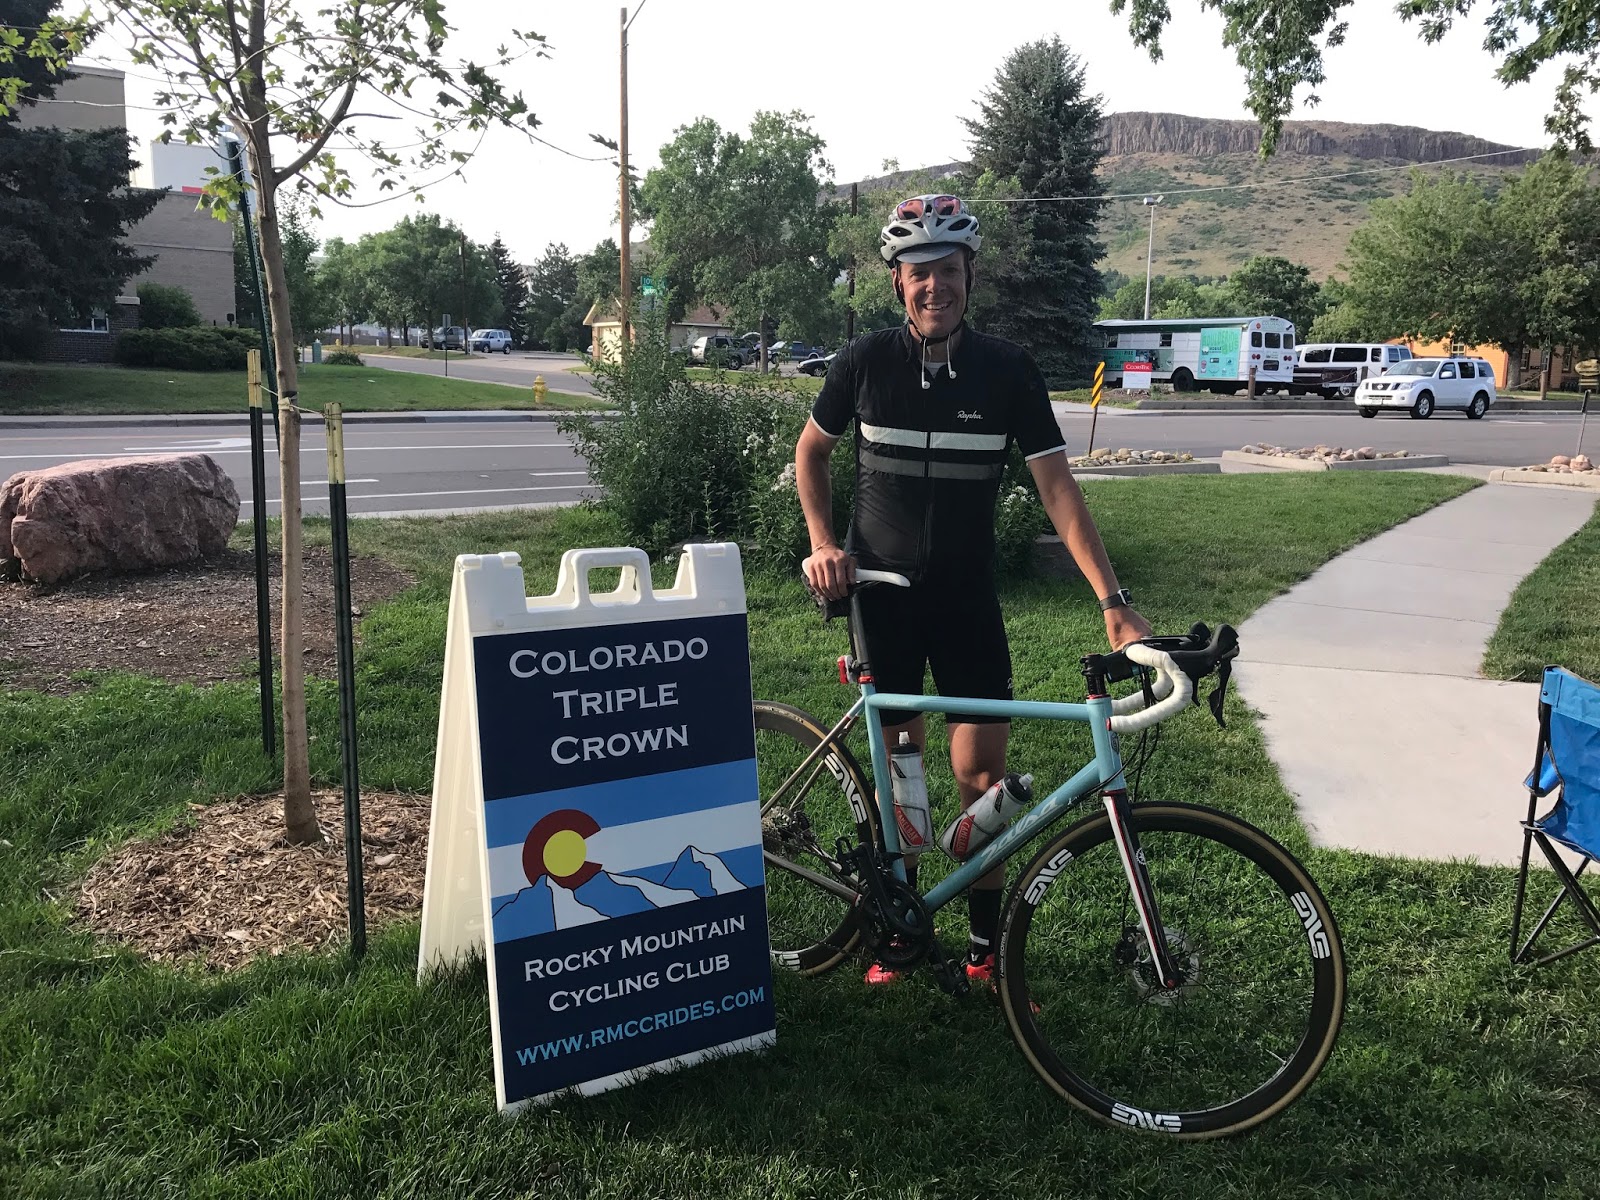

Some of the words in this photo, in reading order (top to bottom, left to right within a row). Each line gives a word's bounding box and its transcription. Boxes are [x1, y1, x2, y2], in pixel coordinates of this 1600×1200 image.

[957, 410, 983, 422] Rapha
[509, 638, 708, 678] COLORADO
[553, 682, 678, 718] TRIPLE
[551, 725, 688, 764] CROWN
[525, 945, 613, 981] ROCKY
[621, 915, 746, 959] MOUNTAIN
[549, 972, 659, 1011] CYCLING
[666, 955, 730, 982] CLUB
[516, 986, 765, 1066] WWW.RMCCRIDES.COM
